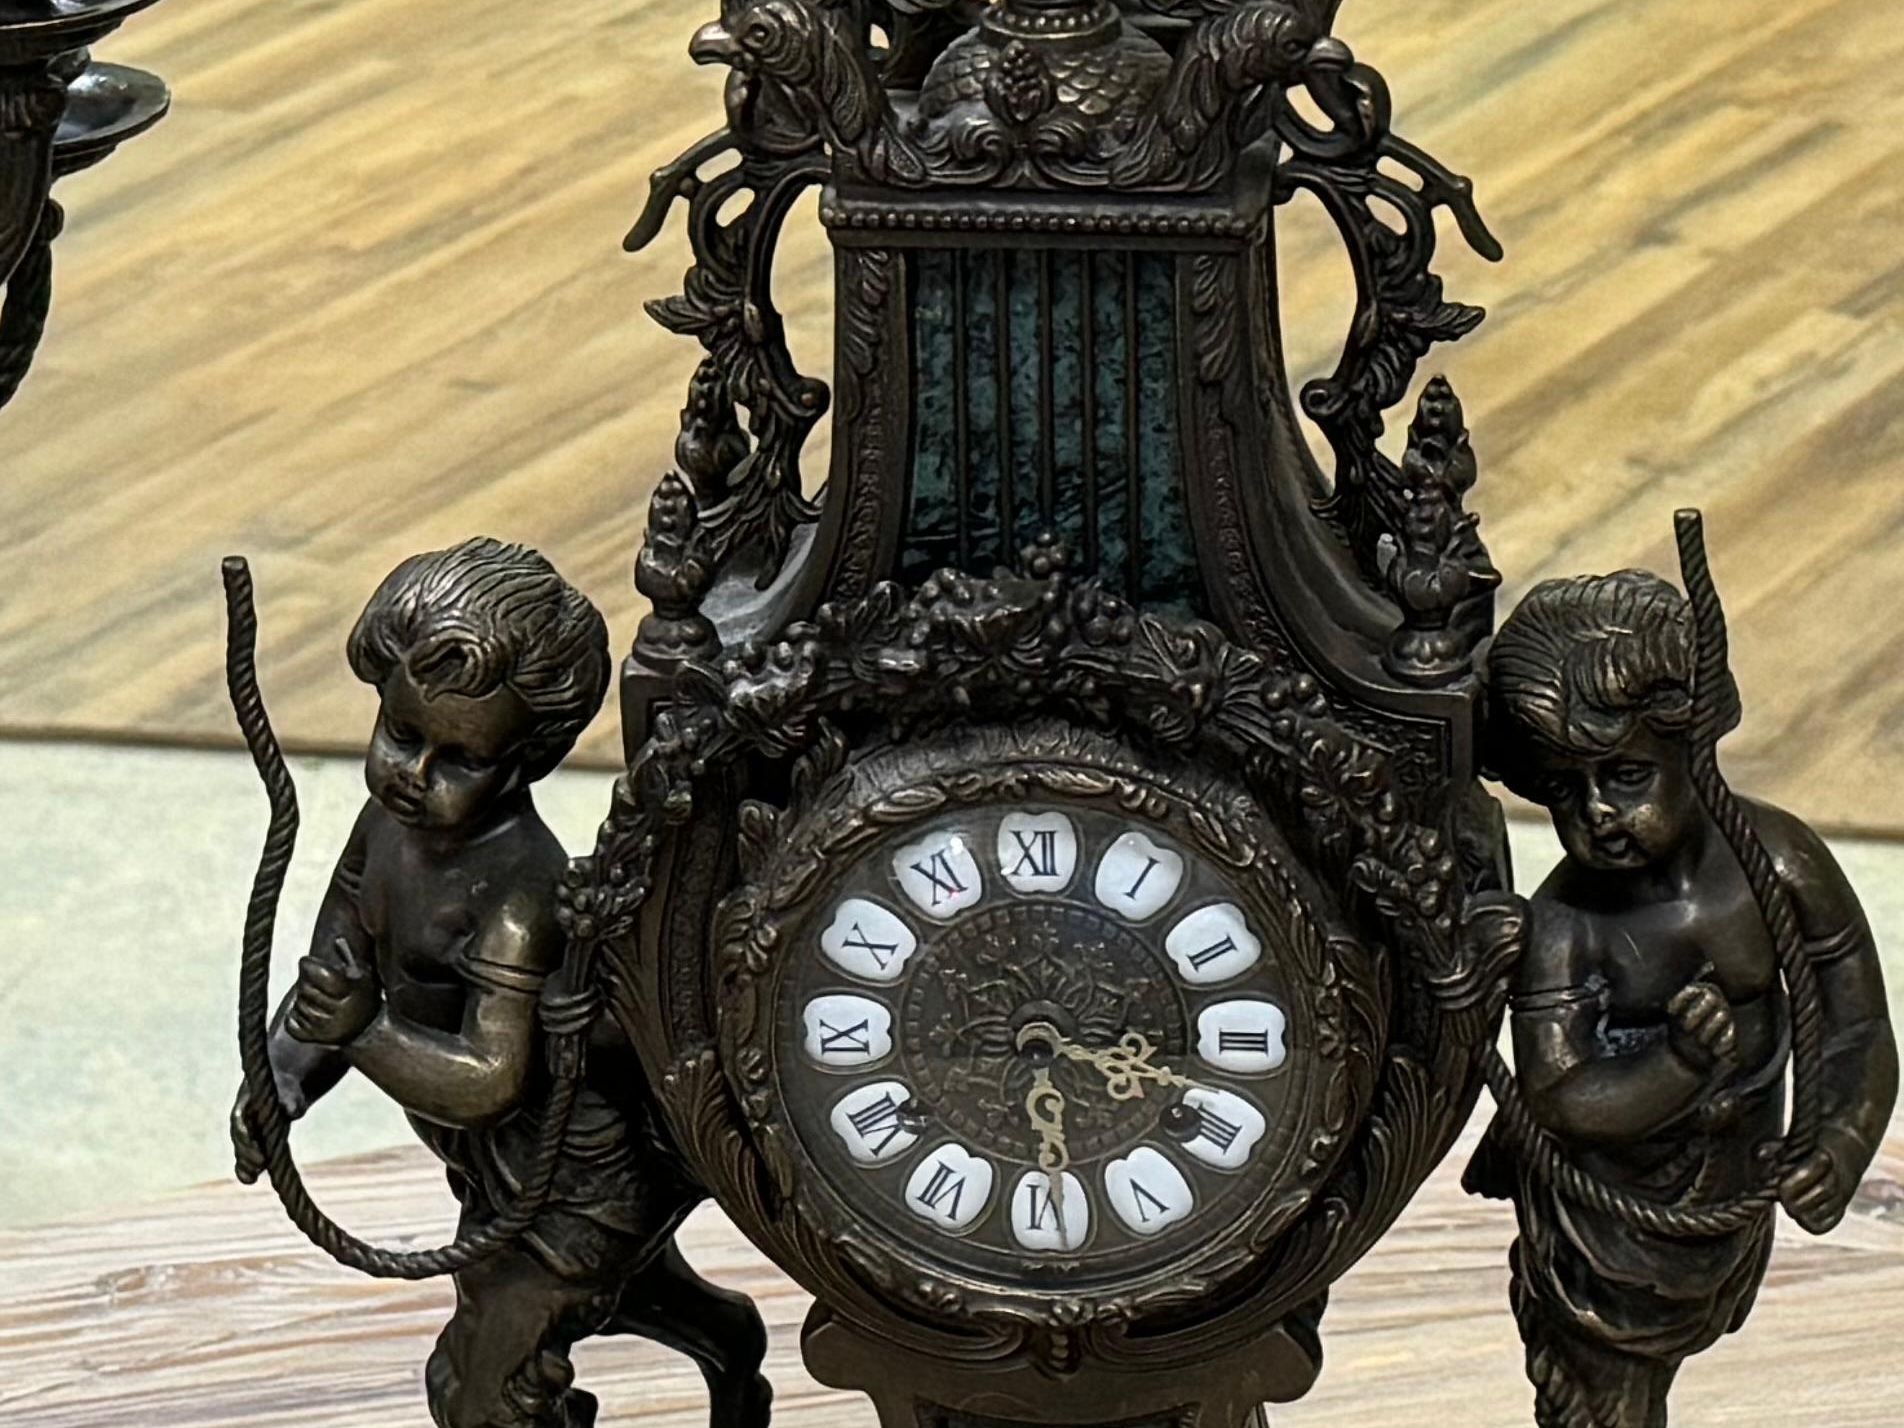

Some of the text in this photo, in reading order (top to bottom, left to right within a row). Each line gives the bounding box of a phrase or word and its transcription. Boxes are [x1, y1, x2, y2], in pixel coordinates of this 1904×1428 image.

[1009, 829, 1059, 876] XII
[910, 848, 968, 906] XI
[1123, 857, 1161, 901] I
[841, 921, 898, 970] X
[1186, 932, 1238, 973] II
[819, 1018, 870, 1055] IX
[1219, 1028, 1269, 1054] III
[845, 1091, 901, 1156] VIII
[917, 1161, 966, 1221] VII
[1026, 1184, 1066, 1231] VI
[1130, 1179, 1171, 1223] V
